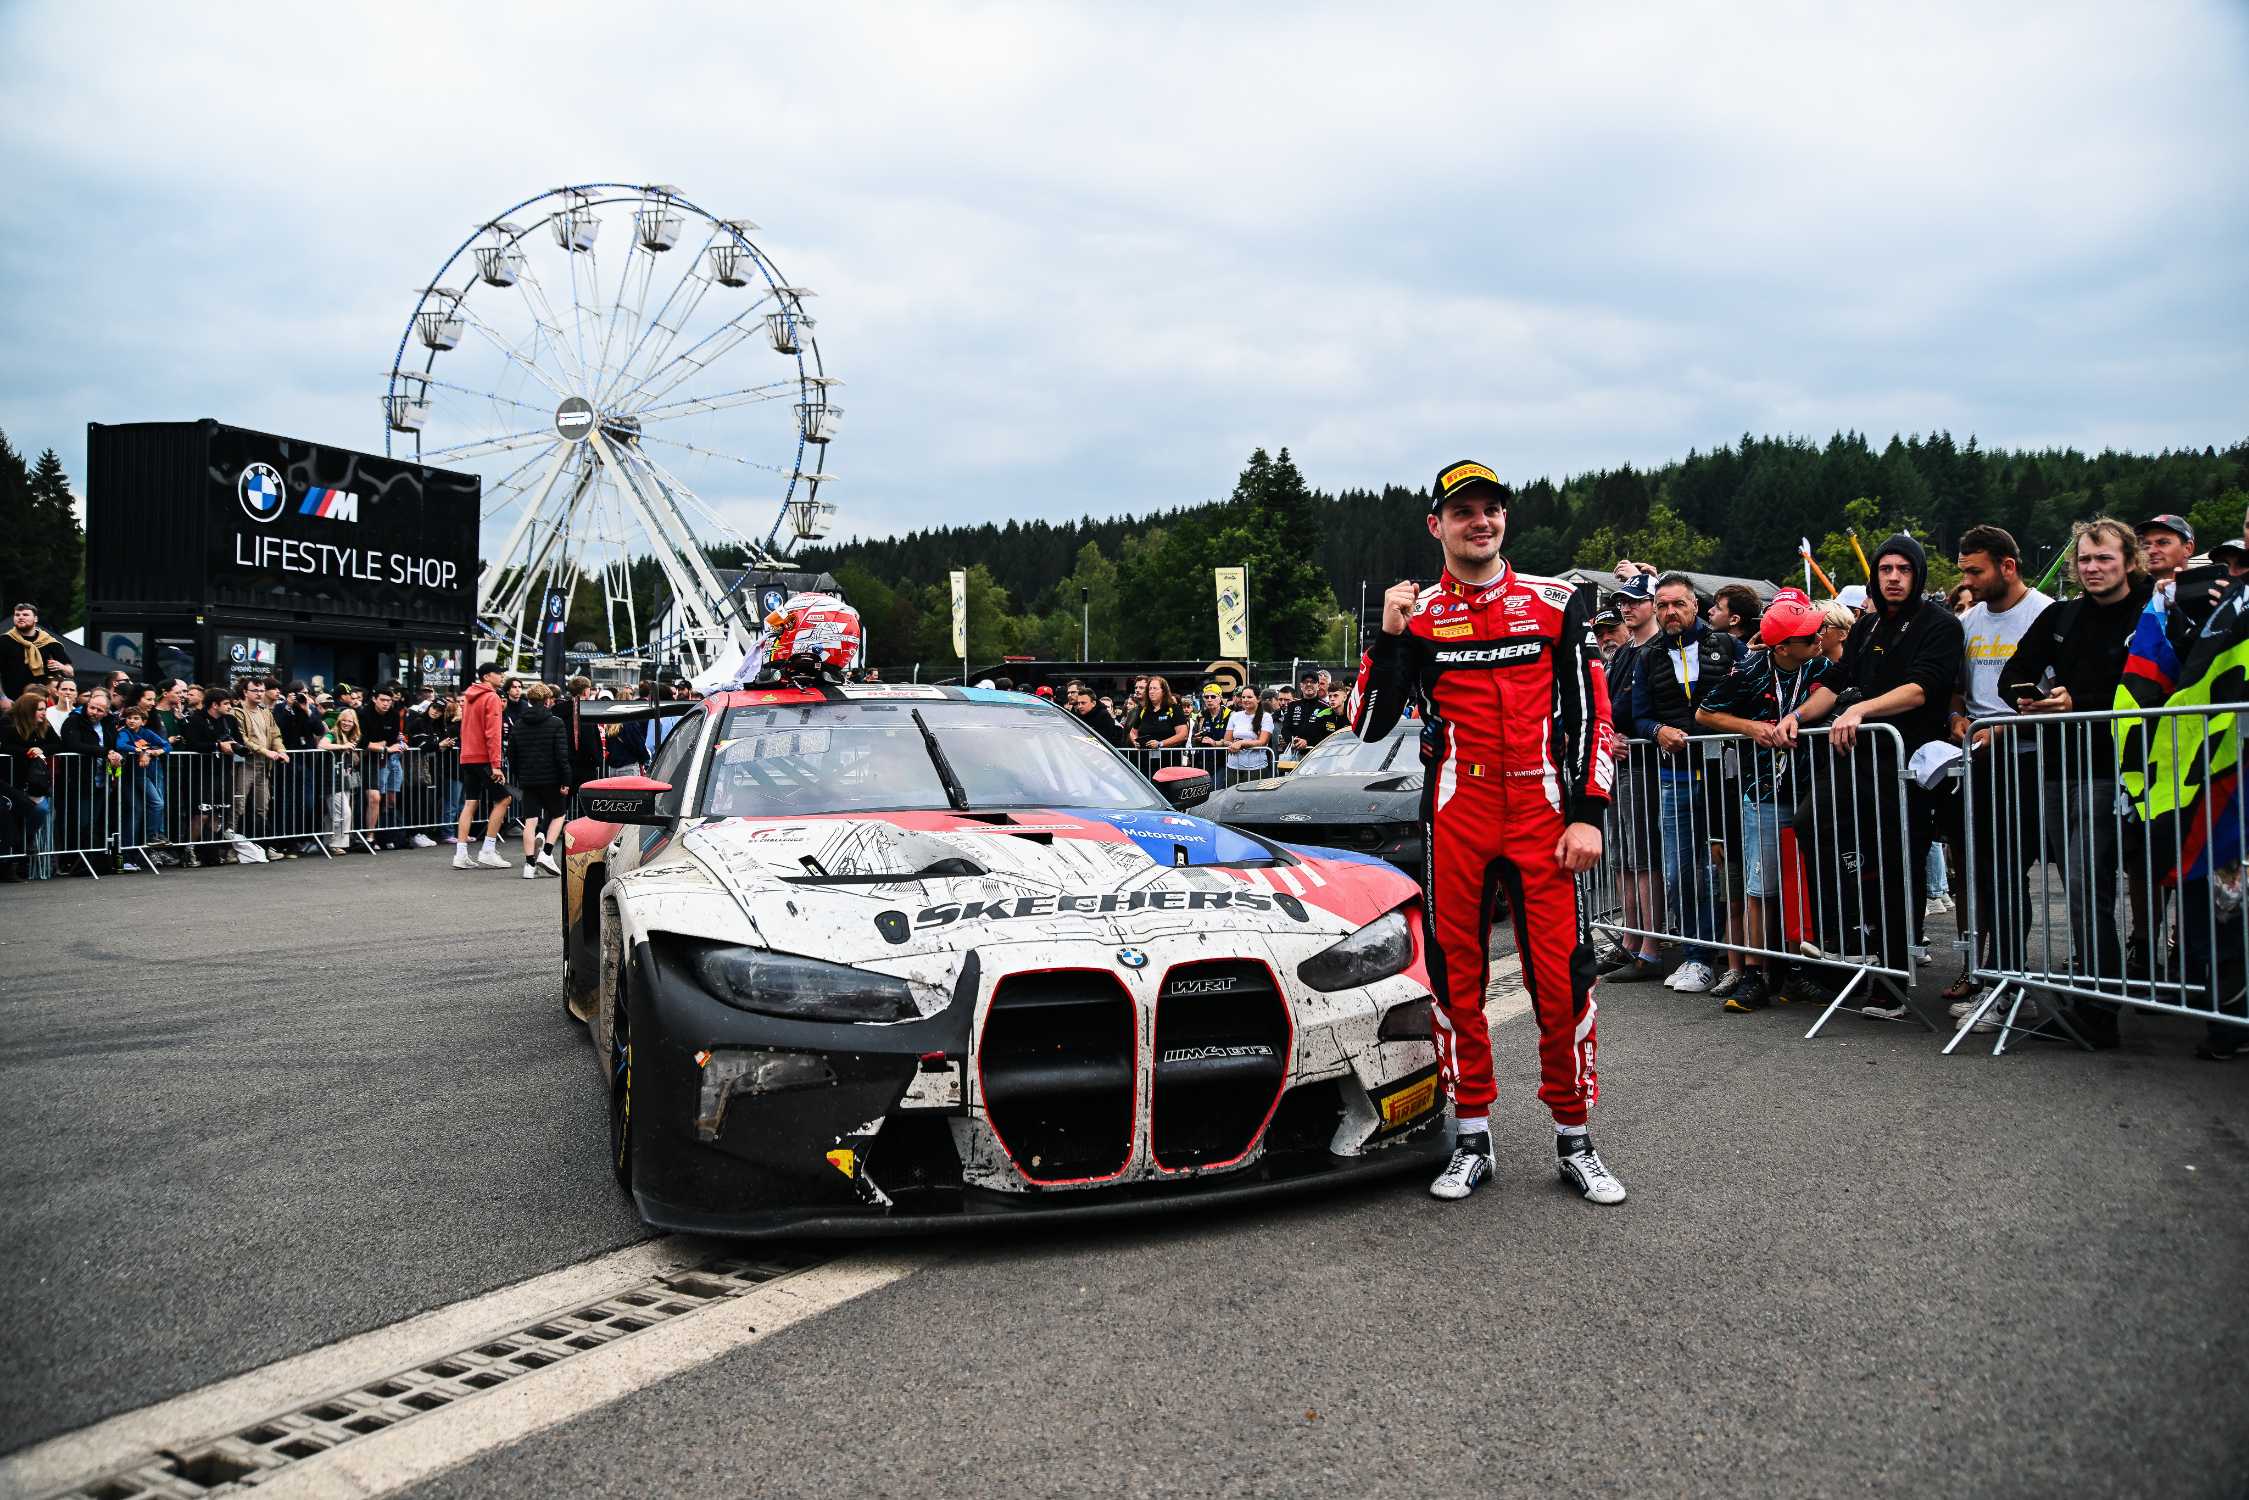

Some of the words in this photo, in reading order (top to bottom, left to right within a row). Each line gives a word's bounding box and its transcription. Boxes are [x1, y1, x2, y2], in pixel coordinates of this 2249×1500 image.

[236, 532, 383, 581] LIFESTYLE
[389, 553, 458, 590] SHOP.
[1543, 589, 1568, 601] OMP
[1434, 615, 1468, 626] Motorsport
[1435, 641, 1542, 662] SKECHERS
[1514, 768, 1545, 777] VANTHOOR
[591, 799, 643, 812] WRT
[1121, 827, 1207, 844] Motorsport
[914, 890, 1272, 930] SKECHERS
[1171, 976, 1237, 995] WRT
